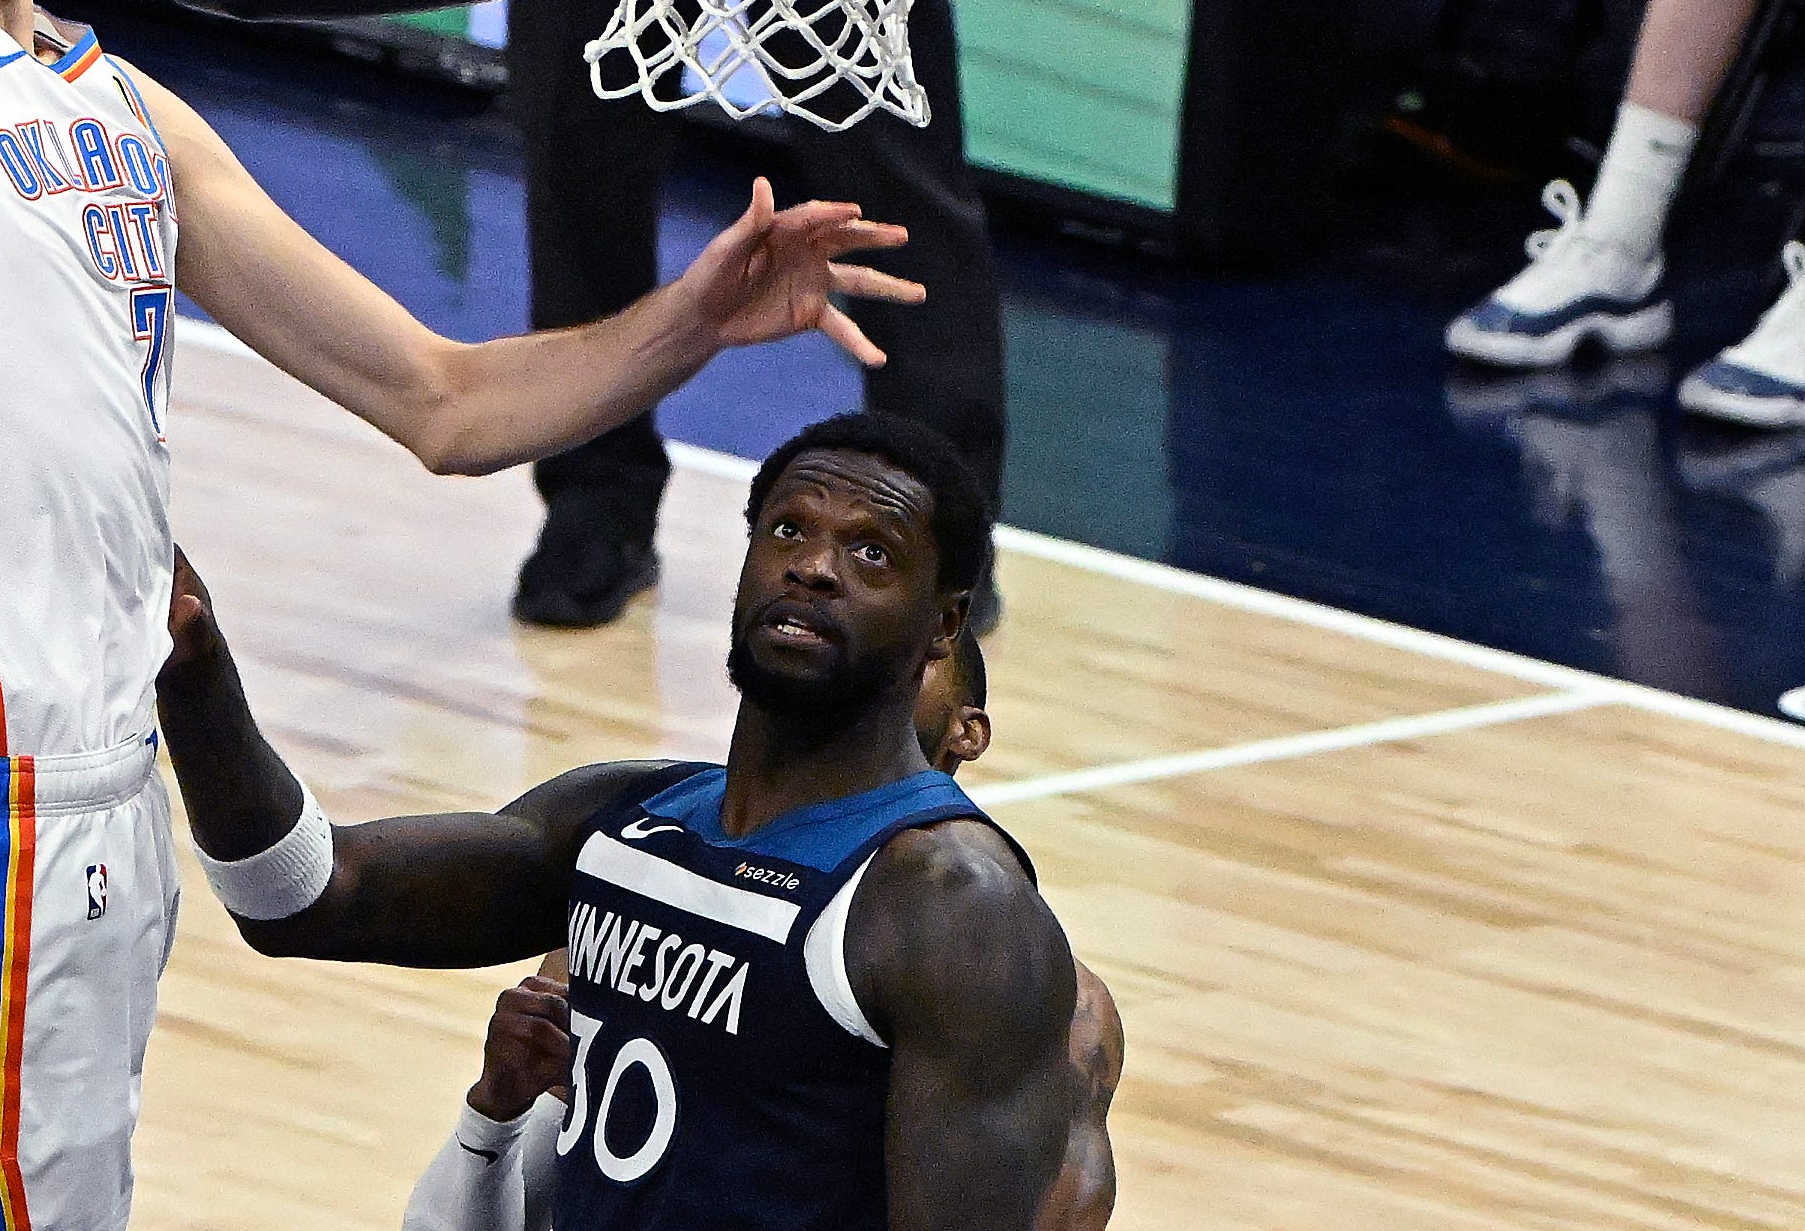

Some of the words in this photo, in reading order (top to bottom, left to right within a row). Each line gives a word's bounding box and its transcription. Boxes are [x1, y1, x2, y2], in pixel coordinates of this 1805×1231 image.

[82, 202, 165, 281] CIT
[129, 284, 172, 443] 7
[744, 866, 800, 889] sezzle
[569, 901, 749, 1035] INNESOTA
